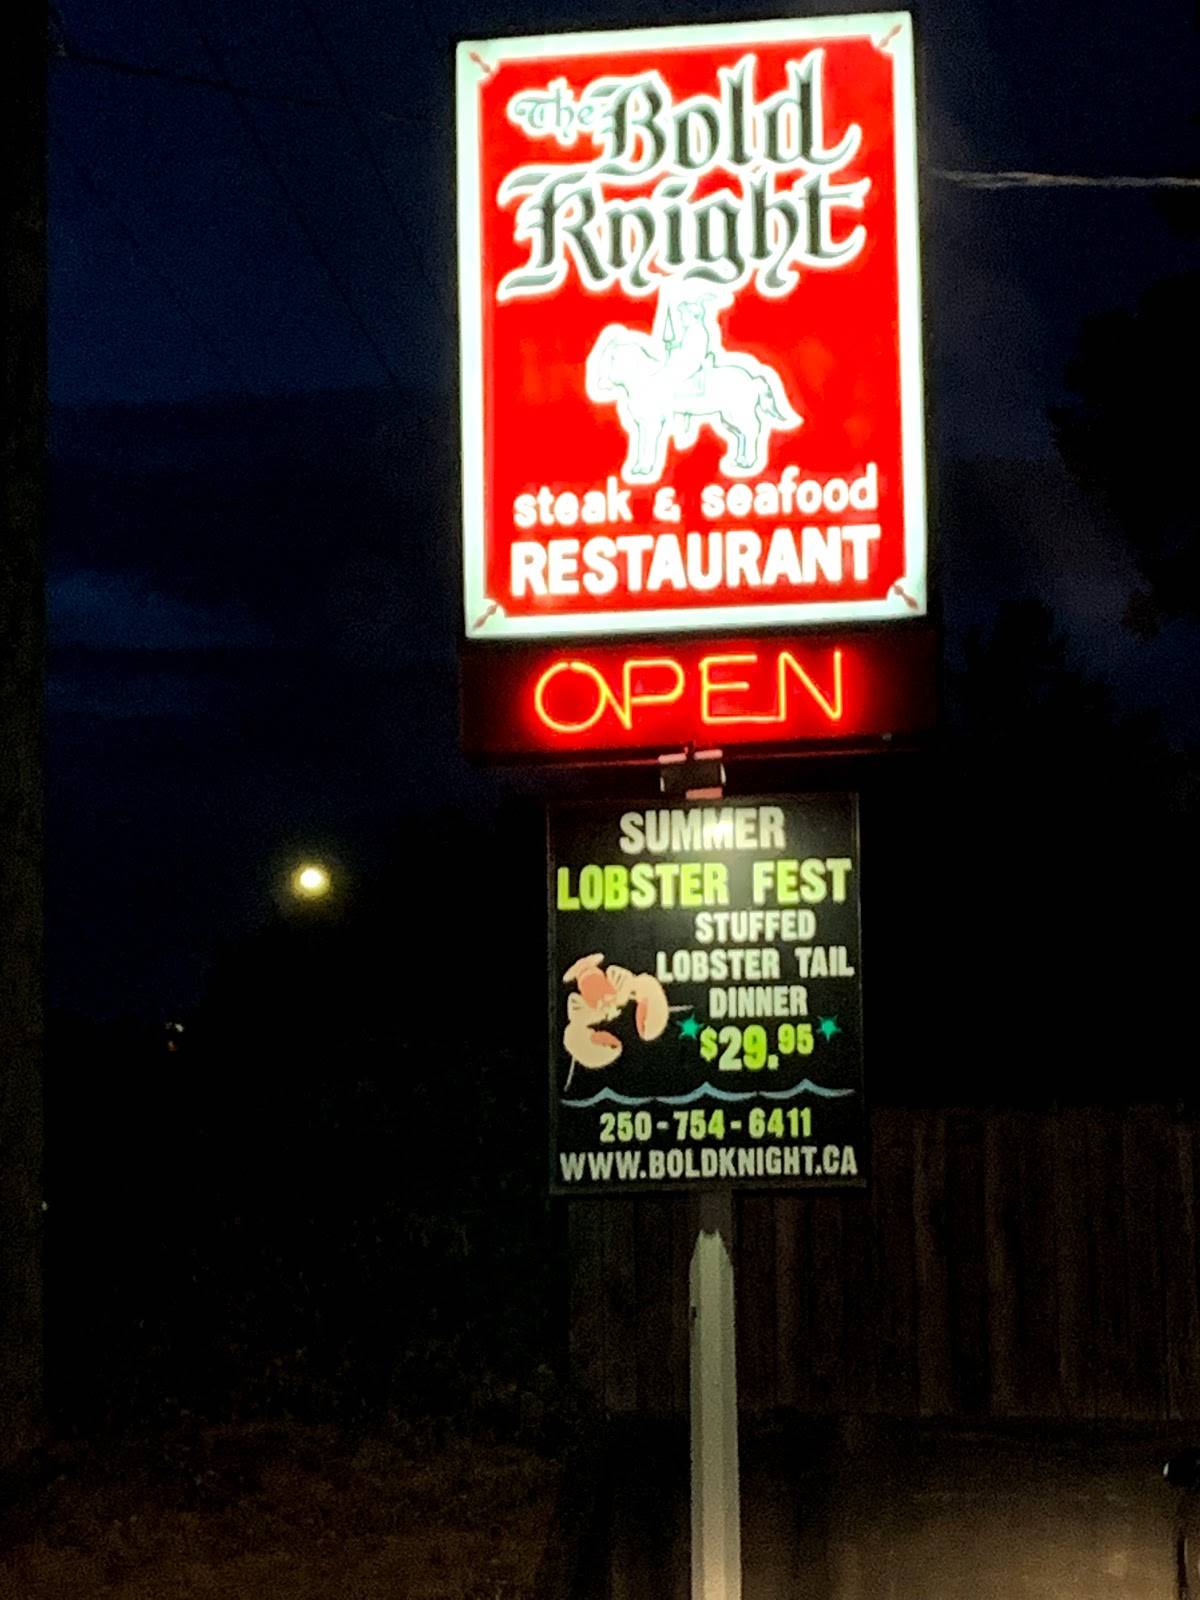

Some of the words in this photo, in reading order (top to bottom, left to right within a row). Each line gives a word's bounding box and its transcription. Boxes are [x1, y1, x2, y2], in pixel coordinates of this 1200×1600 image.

[508, 77, 596, 146] The
[580, 48, 862, 182] Bold
[497, 168, 871, 300] Knight
[513, 477, 633, 528] steak
[653, 486, 681, 522] &
[701, 462, 878, 519] seafood
[510, 523, 881, 597] RESTAURANT
[534, 650, 843, 733] OPEN
[619, 805, 786, 855] SUMMER
[557, 862, 729, 912] LOBSTER
[753, 857, 852, 905] FEST
[695, 909, 816, 944] STUFFED
[656, 948, 780, 983] LOBSTER
[795, 945, 855, 978] TAIL
[709, 985, 808, 1018] DINNER
[700, 1023, 814, 1072] $29.95
[560, 1145, 858, 1182] WWW.BOLDKNIGHT.CA
